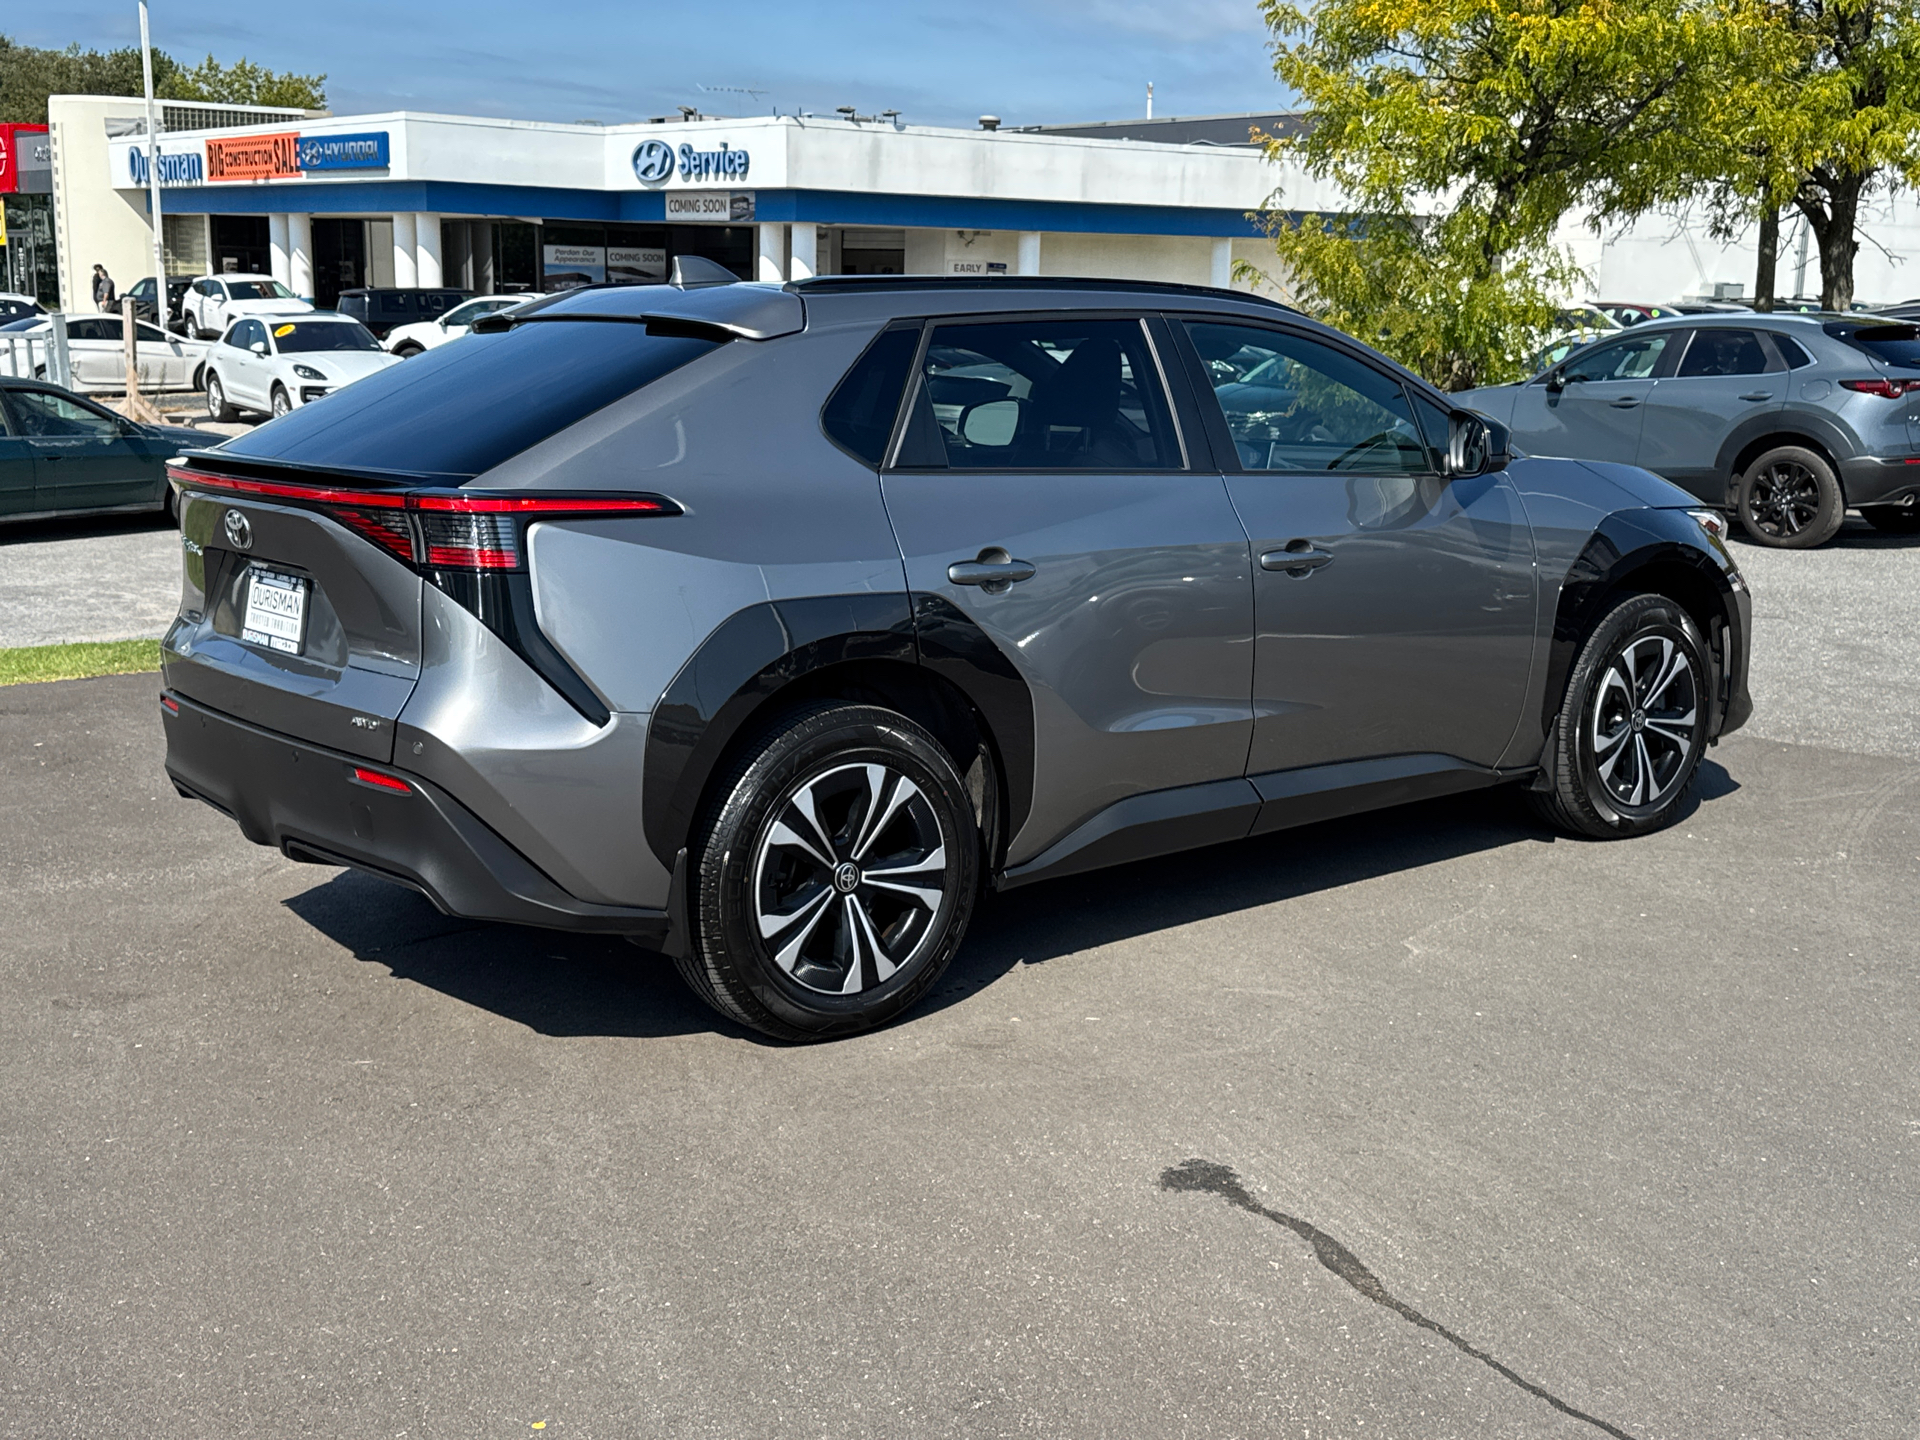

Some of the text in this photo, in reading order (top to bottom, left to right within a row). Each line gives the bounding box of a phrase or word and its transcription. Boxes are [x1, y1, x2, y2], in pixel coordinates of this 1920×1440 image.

[208, 137, 301, 177] BIG CONSTRUCTION SALE
[324, 140, 379, 162] HYUNDAI
[678, 142, 750, 176] Service
[129, 145, 203, 183] Ousman
[669, 199, 727, 213] COMING SOON
[555, 248, 580, 256] Pardon
[609, 252, 664, 263] COMING SOON
[953, 263, 982, 273] EARLY
[252, 586, 301, 615] OURISMAN
